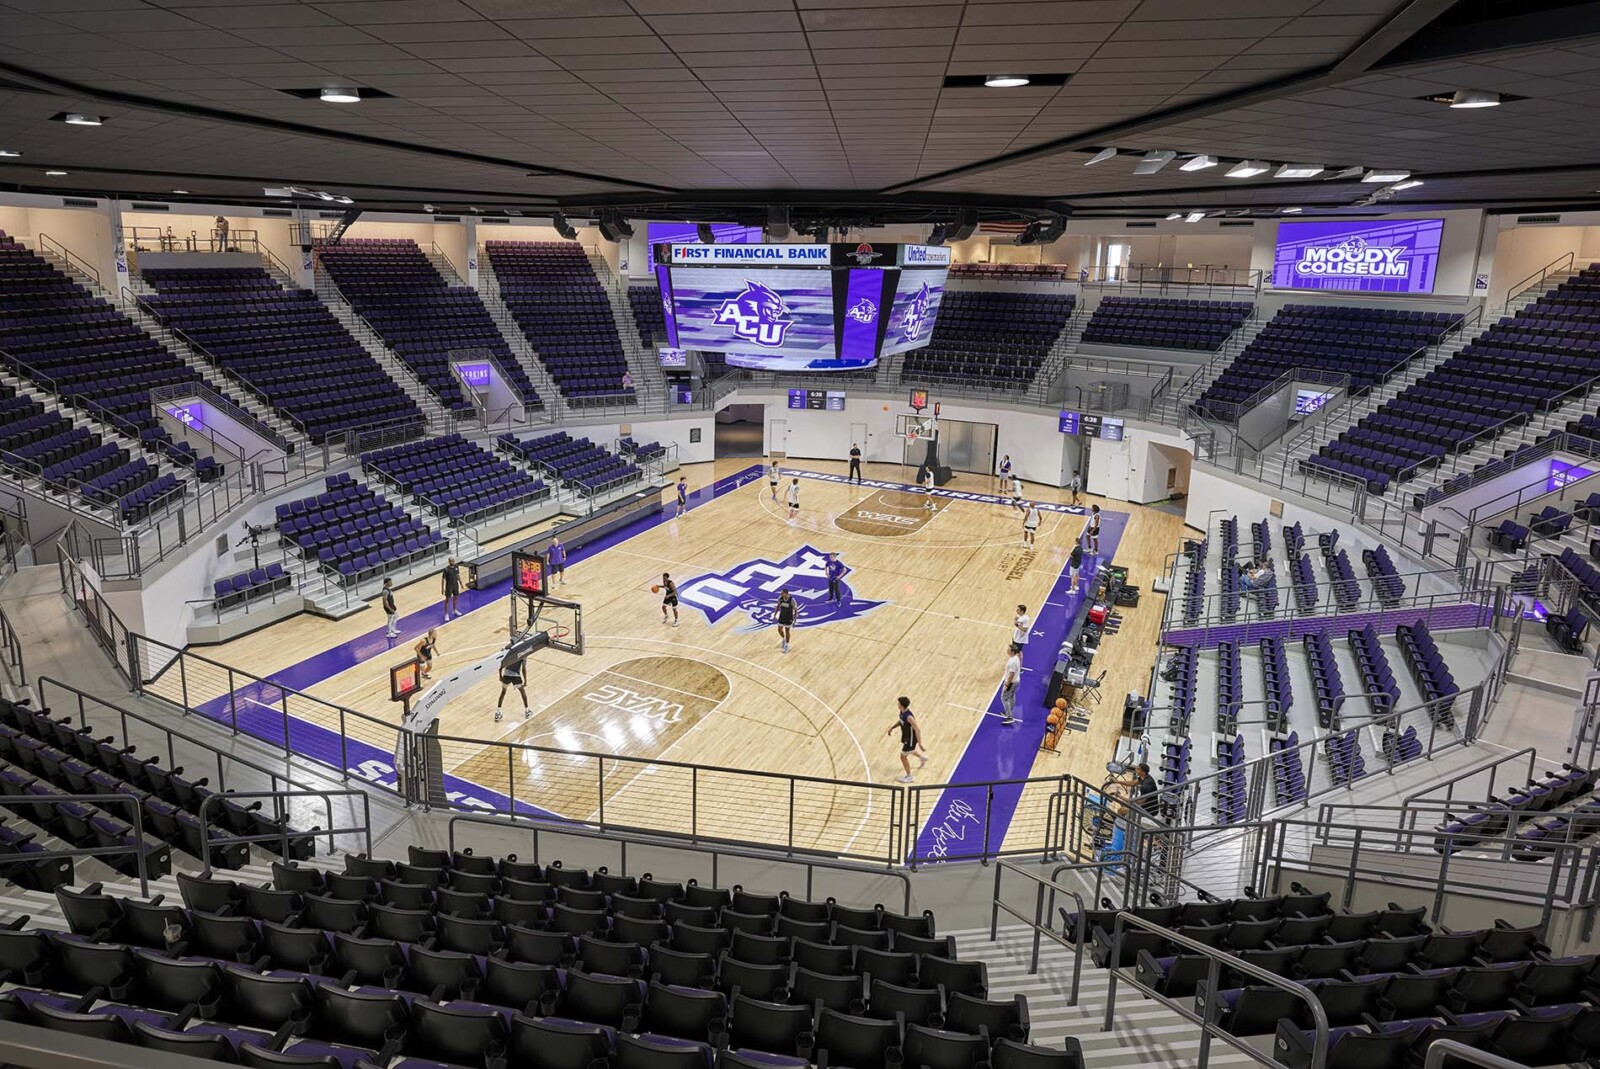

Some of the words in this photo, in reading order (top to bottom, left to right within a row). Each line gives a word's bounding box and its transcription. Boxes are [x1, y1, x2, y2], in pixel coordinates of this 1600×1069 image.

[674, 247, 709, 259] FIRST
[714, 248, 783, 259] FINANCIAL
[788, 248, 827, 259] BANK
[908, 246, 926, 262] United
[1306, 248, 1402, 263] MOODY
[1298, 261, 1407, 275] COLISEUM
[850, 307, 872, 322] ACU
[903, 303, 923, 339] ACU
[719, 303, 783, 343] ACU
[680, 551, 830, 613] ACU
[582, 684, 685, 724] WAC
